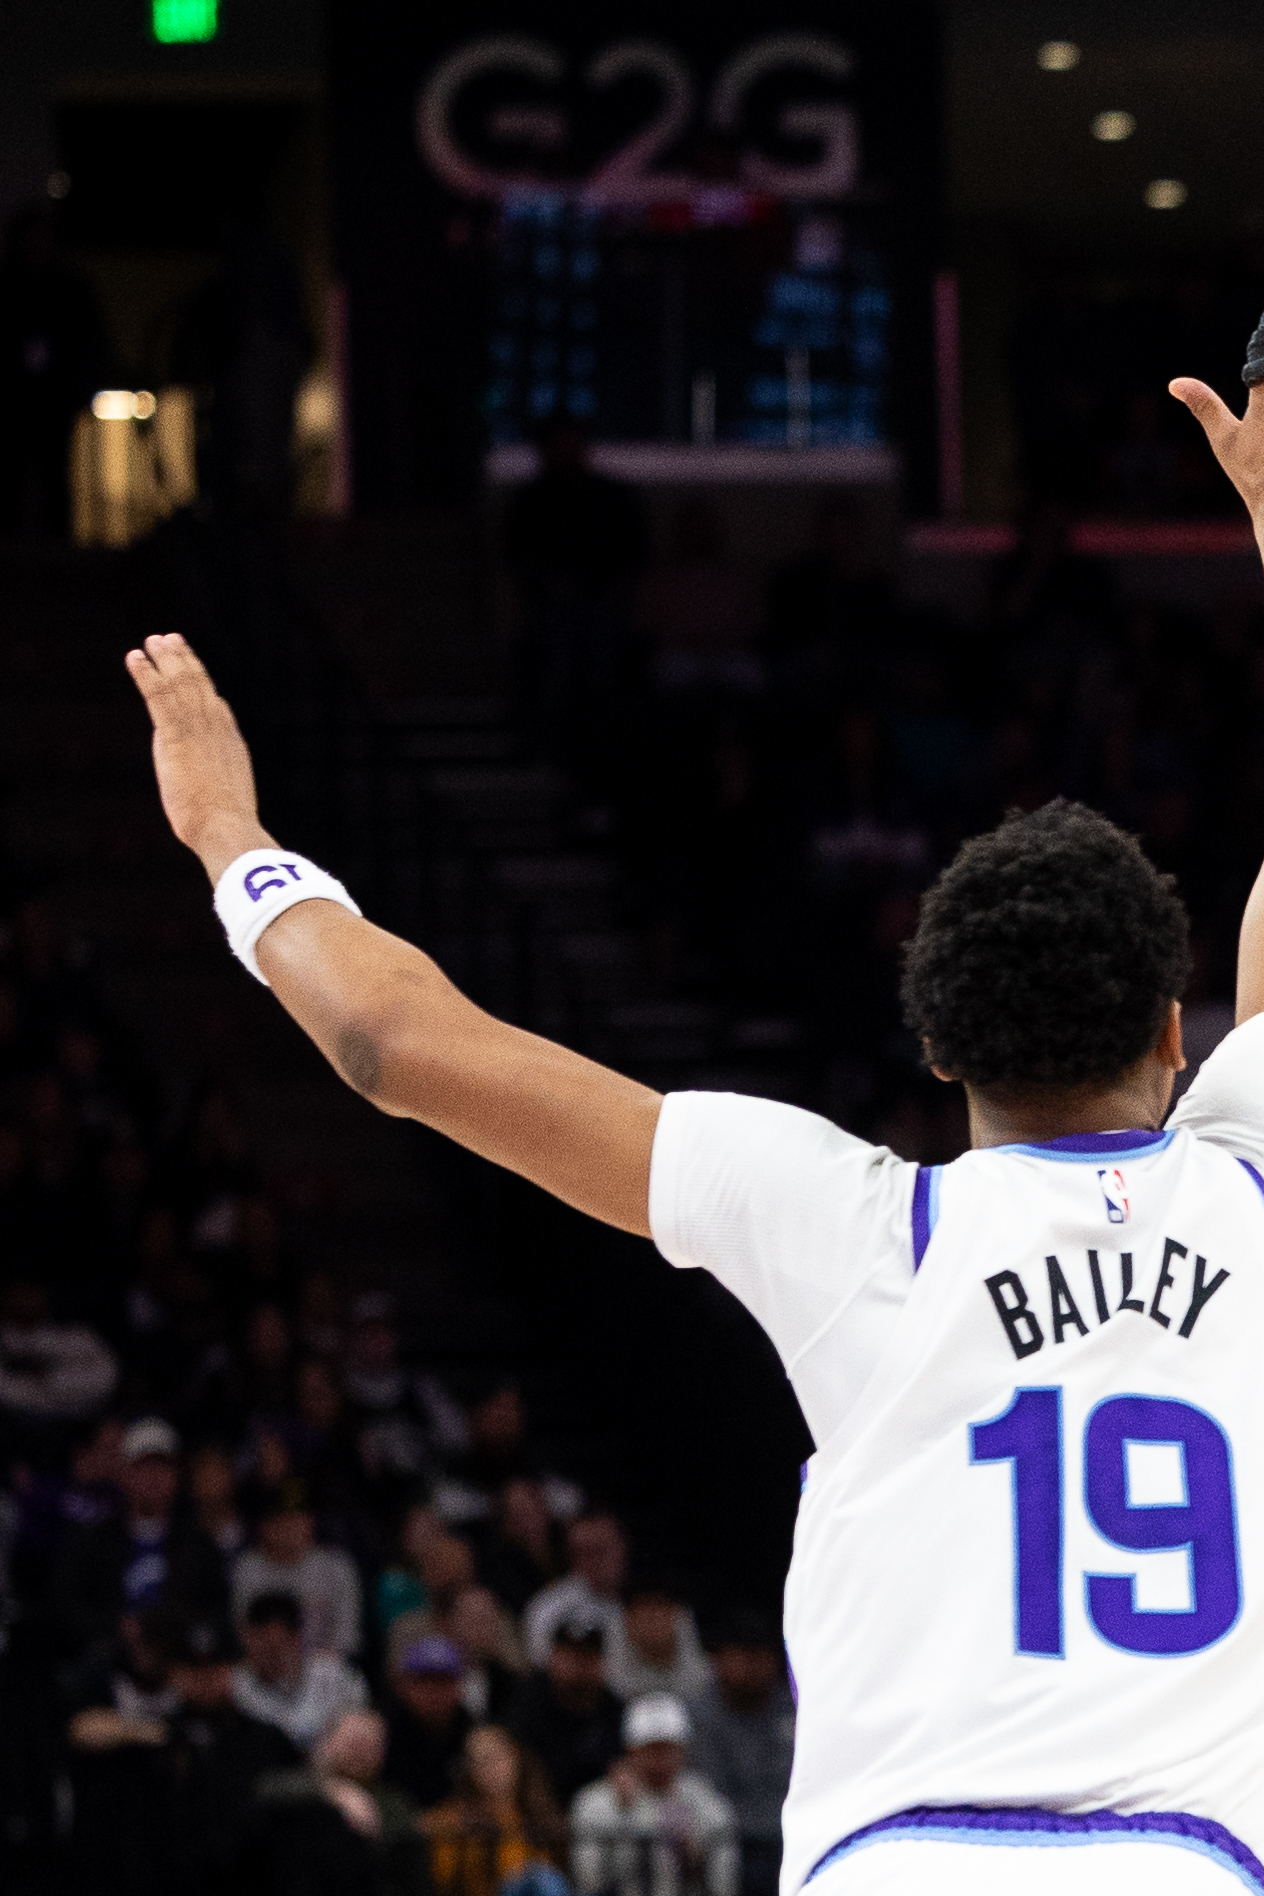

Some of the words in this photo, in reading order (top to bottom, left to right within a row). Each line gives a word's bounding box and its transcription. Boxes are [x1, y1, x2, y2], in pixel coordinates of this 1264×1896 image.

[414, 32, 866, 200] G2G
[983, 1236, 1232, 1361] BAILEY
[966, 1384, 1245, 1660] 19
